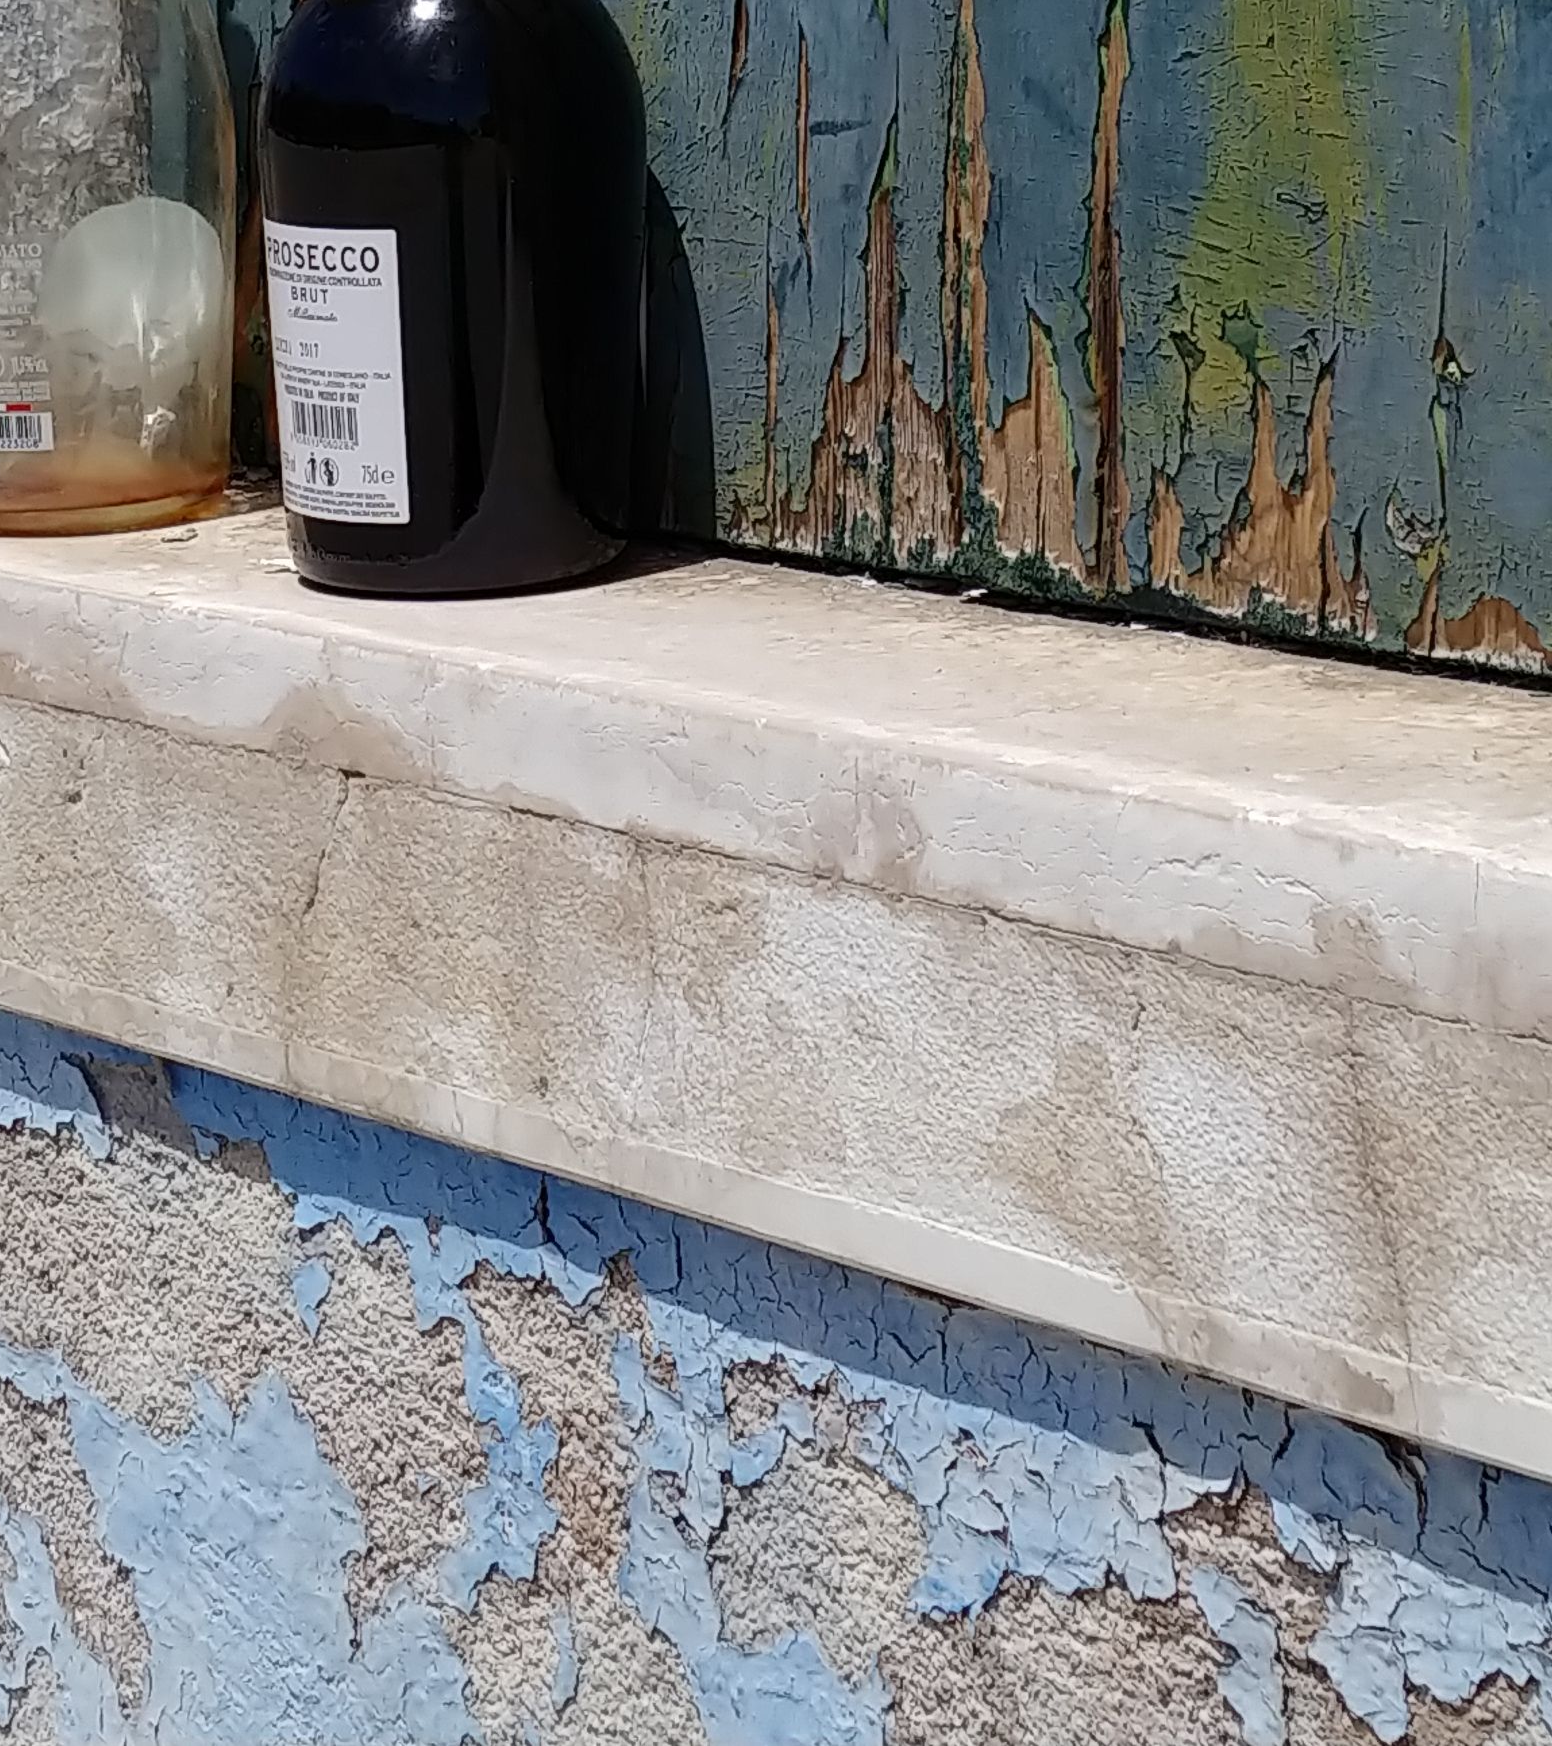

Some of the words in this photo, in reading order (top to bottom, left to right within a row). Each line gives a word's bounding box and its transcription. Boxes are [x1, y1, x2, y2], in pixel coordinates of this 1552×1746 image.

[266, 236, 380, 273] PROSECCO
[328, 276, 383, 287] CONTROLLATA
[290, 286, 329, 304] BRUT
[299, 341, 320, 358] 2017
